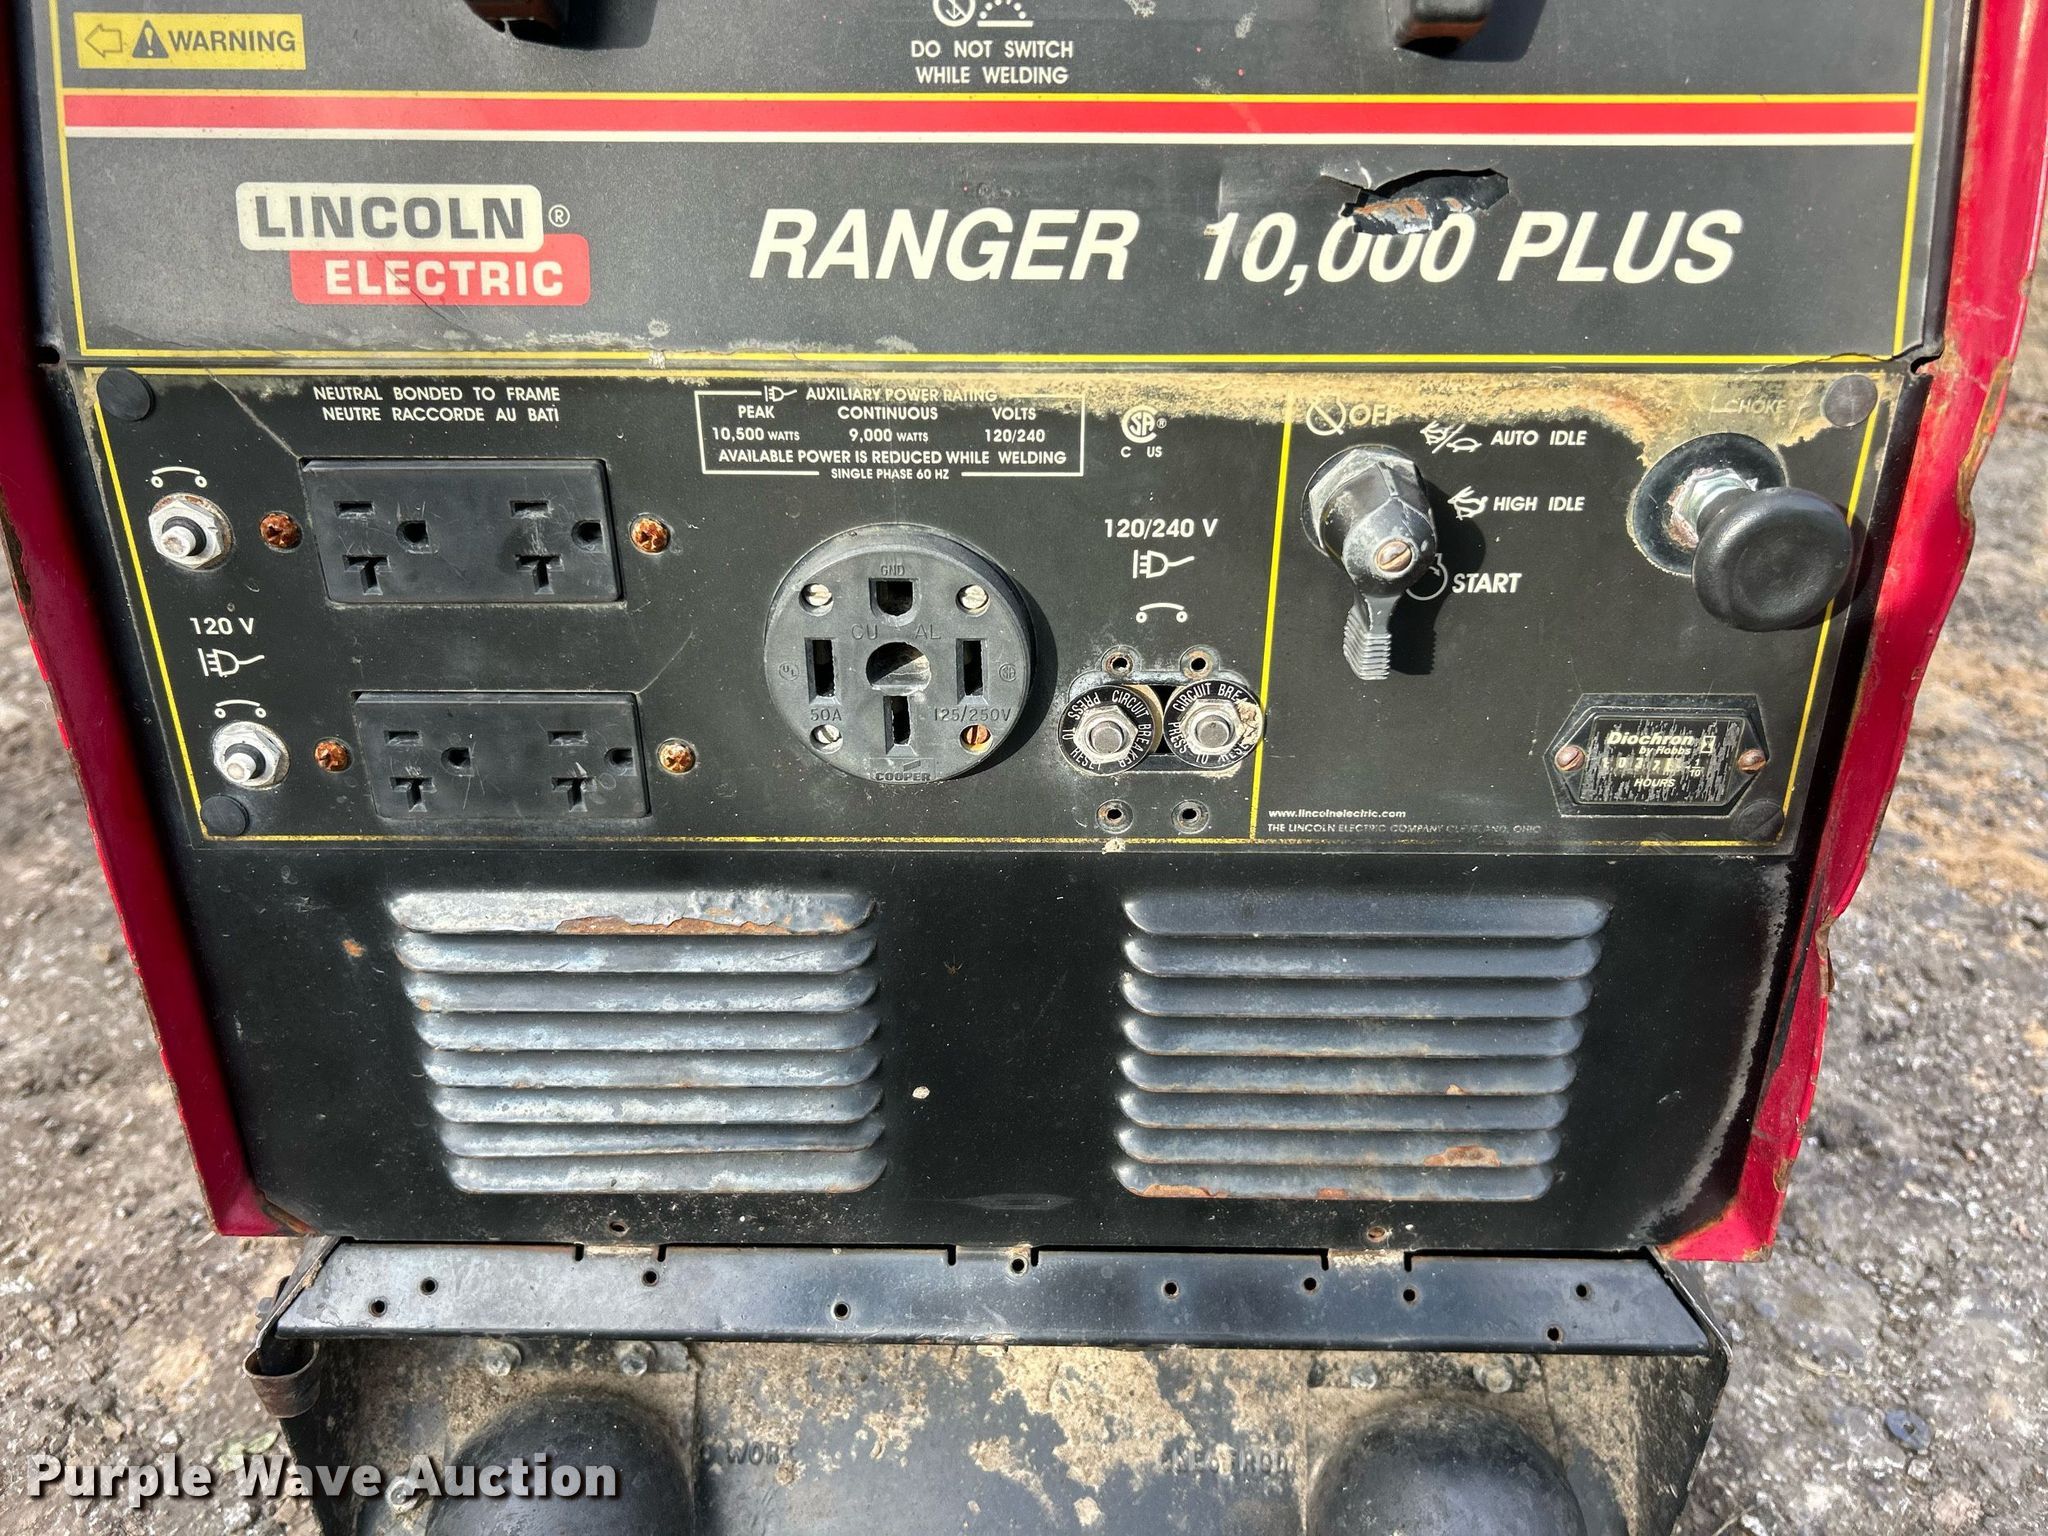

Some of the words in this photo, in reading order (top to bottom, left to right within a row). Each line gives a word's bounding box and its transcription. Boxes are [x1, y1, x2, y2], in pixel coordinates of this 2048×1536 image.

[168, 30, 296, 53] WARNING
[911, 40, 941, 58] DO
[954, 40, 993, 58] NOT
[1004, 40, 1074, 58] SWITCH
[915, 66, 971, 84] WHILE
[982, 66, 1069, 84] WELDING
[255, 195, 523, 240] LINCOLN
[750, 208, 1139, 281] RANGER
[1497, 209, 1744, 284] PLUS
[325, 260, 563, 297] ELECTRIC
[313, 387, 383, 401] NEUTRAL
[393, 387, 463, 401] BONDED
[473, 387, 496, 401] TO
[506, 387, 560, 401] FRAME
[806, 386, 881, 402] AUXILIARY
[885, 387, 939, 403] POWER
[943, 387, 998, 402] RATING
[322, 407, 382, 421] NEUTRE
[392, 407, 485, 421] RACCORDE
[496, 407, 517, 421] AU
[737, 405, 775, 419] PEAK
[837, 406, 938, 420] CONTINUOUS
[992, 407, 1036, 421] VOLTS
[1349, 404, 1397, 425] OFF
[712, 427, 765, 442] 10,500
[768, 430, 800, 441] WATTS
[848, 428, 893, 443] 9,000
[896, 431, 929, 442] WATTS
[984, 428, 1046, 443] 120/240
[1490, 430, 1539, 446] AUTO
[1549, 430, 1587, 446] IDLE
[718, 450, 794, 464] AVAILABLE
[798, 450, 851, 464] POWER
[855, 450, 868, 464] IS
[872, 450, 942, 465] REDUCED
[946, 451, 990, 465] WHILE
[998, 451, 1067, 465] WELDING
[1120, 445, 1132, 458] C
[1146, 445, 1163, 458] US
[831, 468, 873, 480] SINGLE
[876, 468, 913, 480] PHASE
[916, 468, 932, 480] 60
[935, 468, 950, 480] HZ
[1493, 496, 1537, 512] HIGH
[1547, 496, 1585, 512] IDLE
[1104, 518, 1194, 539] 120/240
[1202, 518, 1219, 537] V
[880, 564, 906, 577] GND
[1452, 572, 1523, 594] START
[189, 617, 233, 635] 120
[238, 617, 255, 635] V
[851, 624, 879, 640] CU
[914, 624, 942, 640] AL
[1112, 689, 1150, 718] CIRCUIT
[1172, 682, 1212, 712] CIRCUIT
[1067, 691, 1101, 721] PRESS
[809, 707, 843, 722] 50A
[934, 707, 1012, 722] 125/250V
[1168, 721, 1190, 754] PRESS
[1607, 731, 1694, 745] Diochron
[1118, 723, 1152, 768] BREAKER
[1638, 747, 1653, 756] by
[875, 771, 932, 783] COOPER
[1633, 778, 1676, 788] HOURS
[1267, 823, 1286, 832] THE
[1288, 823, 1336, 832] LINCOLN
